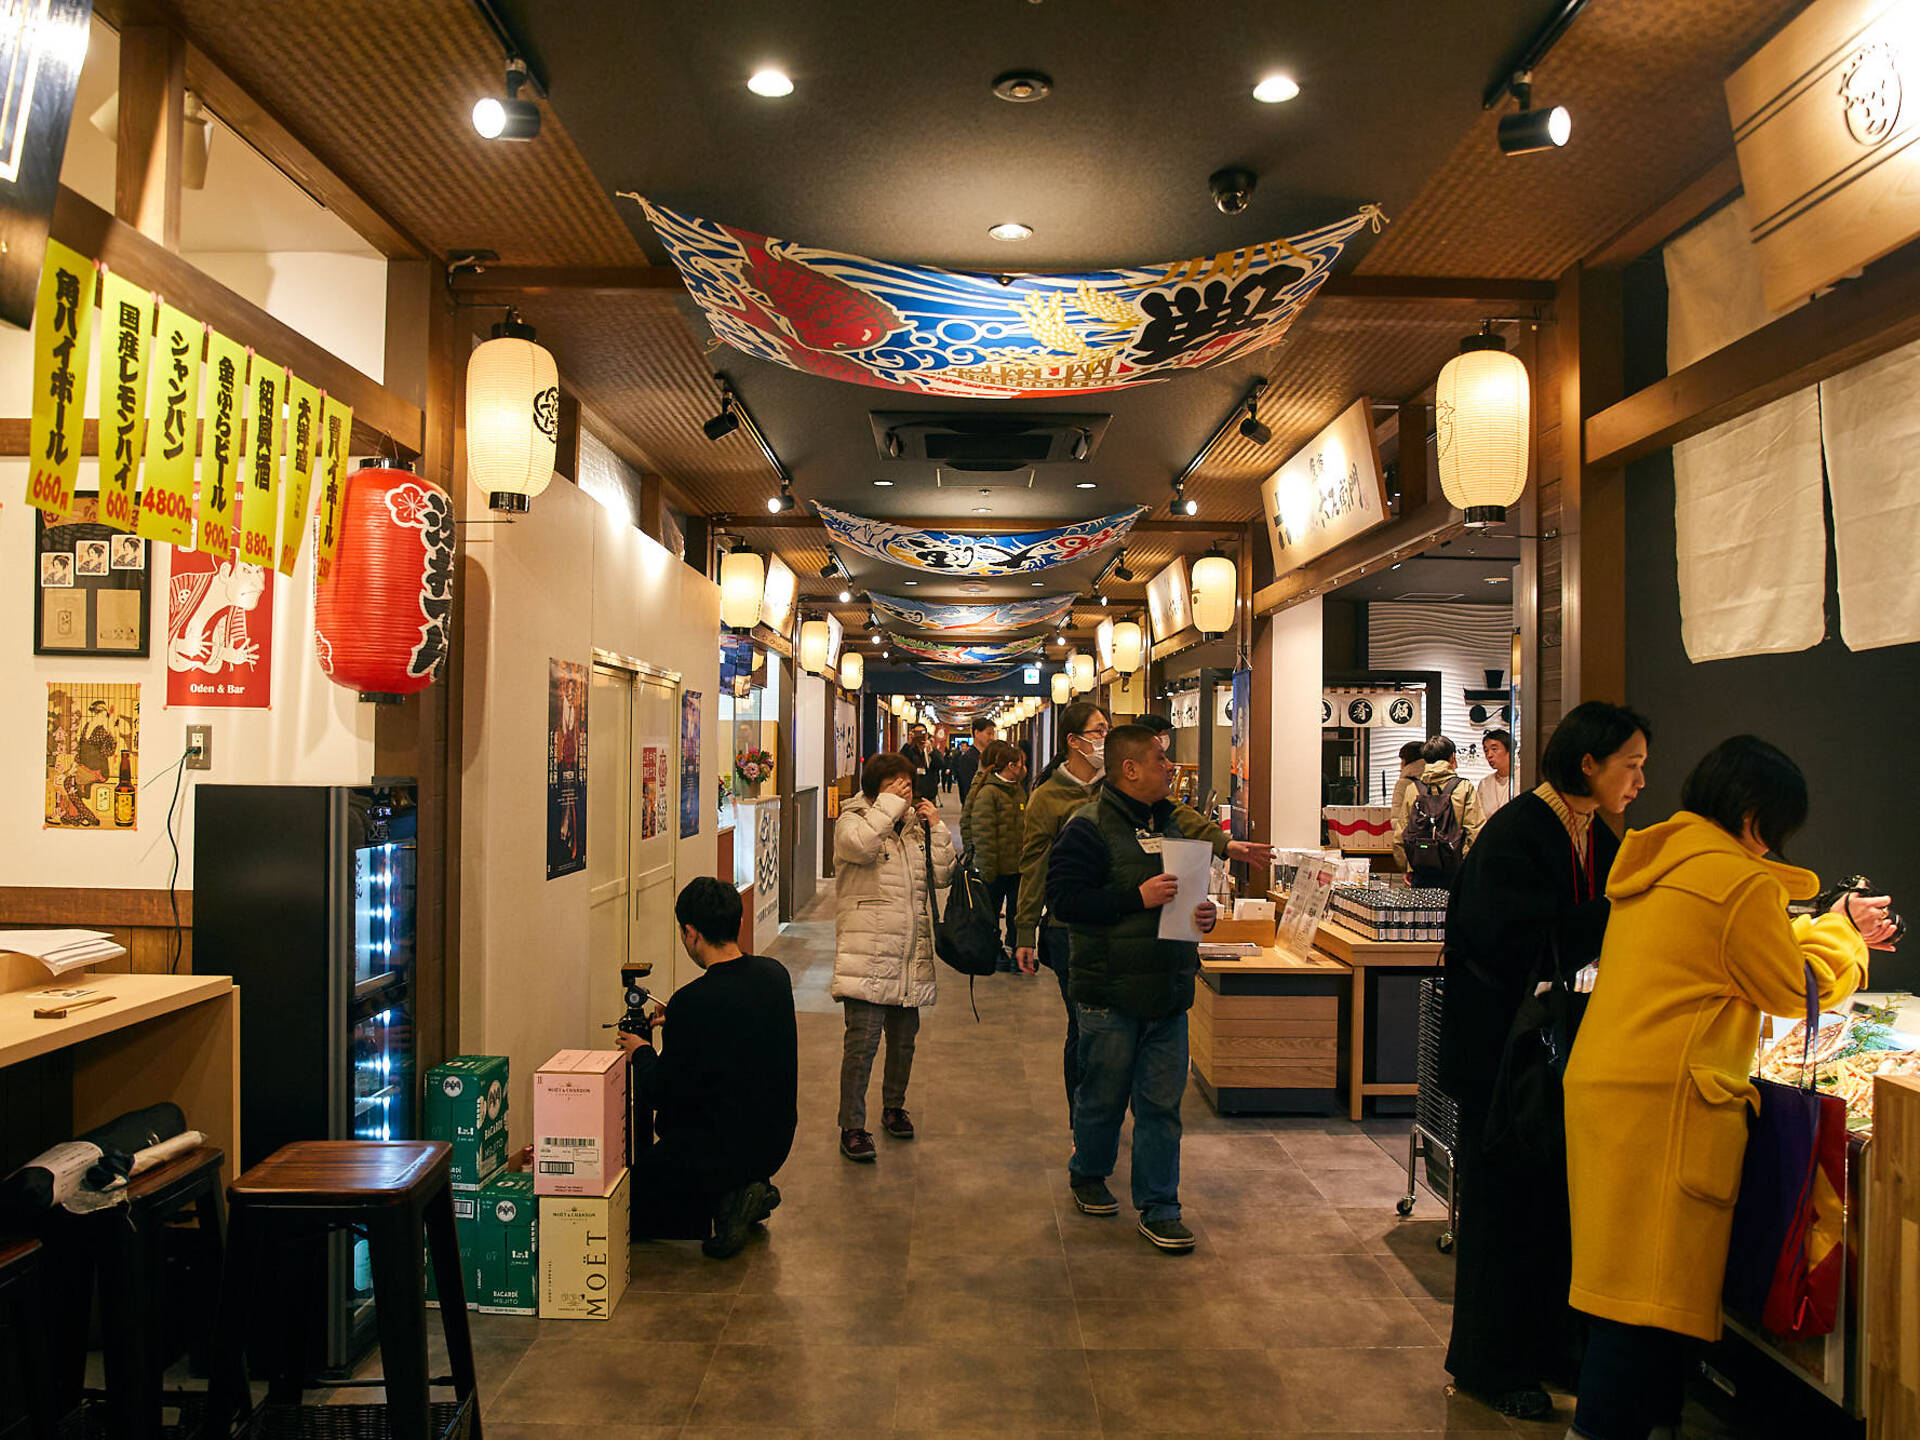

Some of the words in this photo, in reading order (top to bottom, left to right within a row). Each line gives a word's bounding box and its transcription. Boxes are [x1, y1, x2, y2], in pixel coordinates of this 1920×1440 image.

[46, 267, 80, 466] 角ハイボール
[113, 301, 140, 490] 国産レモンハイ
[162, 330, 189, 460] シャンパン
[33, 469, 69, 511] 660円
[142, 485, 192, 525] 4800円
[204, 521, 229, 554] 900円
[245, 531, 272, 562] 880円
[190, 683, 215, 695] Oden
[218, 683, 226, 695] &
[227, 683, 246, 695] Bar
[583, 1230, 607, 1318] MOËT
